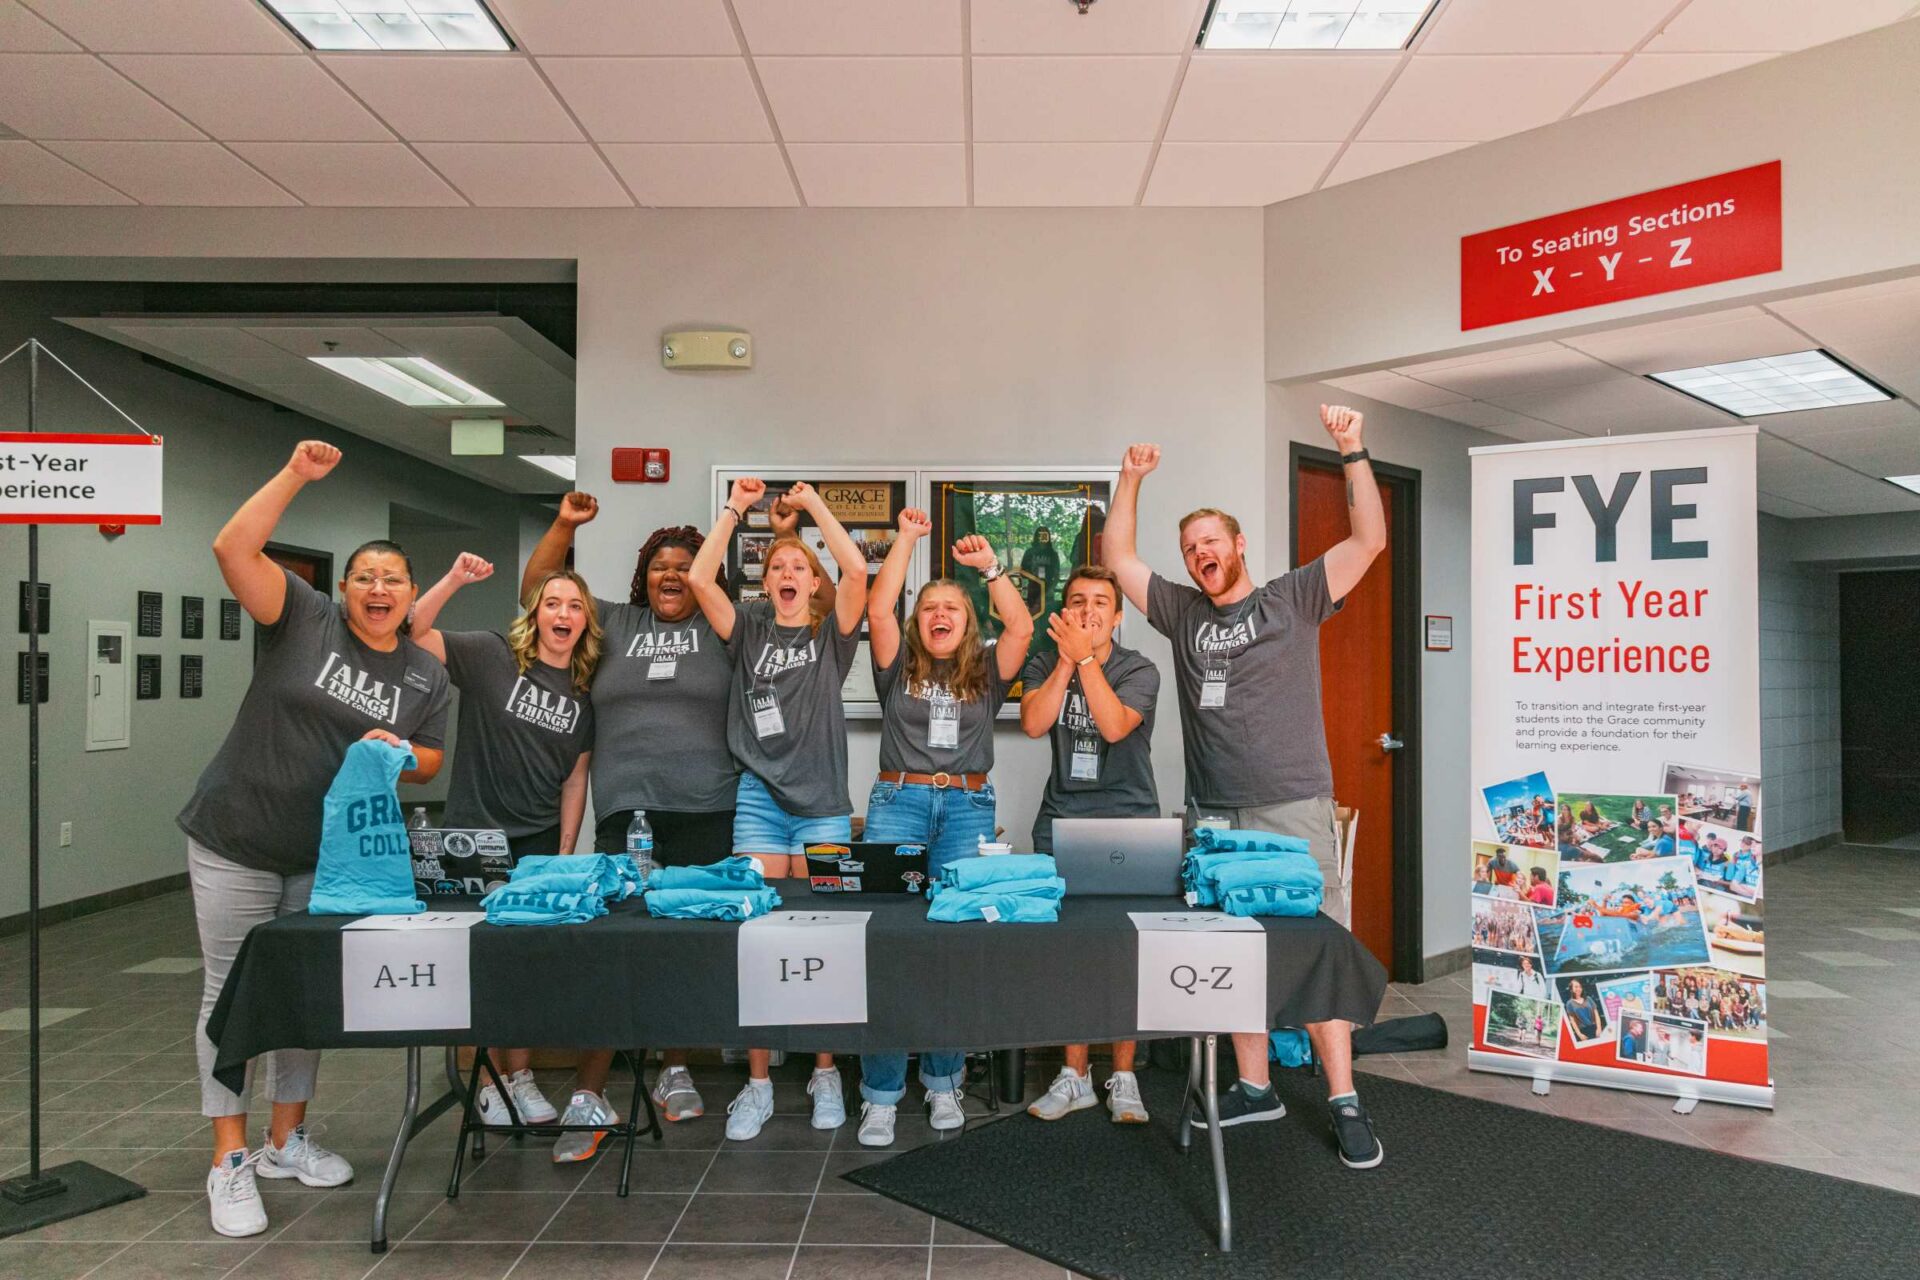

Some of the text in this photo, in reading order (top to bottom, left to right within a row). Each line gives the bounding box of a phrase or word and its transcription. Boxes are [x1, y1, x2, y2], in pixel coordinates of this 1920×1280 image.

[1496, 198, 1736, 265] To Seating Sections
[1531, 266, 1555, 296] X
[1598, 252, 1623, 281] Y
[1669, 236, 1692, 268] Z
[0, 479, 96, 499] erience
[824, 488, 885, 504] GRACE
[1513, 466, 1708, 566] FYE
[1515, 580, 1709, 620] First Year
[639, 631, 690, 648] ALL
[1201, 633, 1249, 651] THINGS
[1204, 622, 1246, 641] ALL
[1513, 636, 1710, 682] Experience
[331, 663, 391, 704] ALL
[327, 689, 384, 721] GRACE COLLEGE
[328, 678, 390, 717] THINGS
[520, 684, 573, 717] ALL
[1515, 701, 1706, 714] To transition and integrate first-year
[516, 700, 571, 729] THINGS
[537, 721, 564, 733] COLLEGE
[1515, 715, 1706, 728] students into the Grace community
[1515, 727, 1535, 737] and
[1538, 727, 1578, 739] provide
[1591, 728, 1650, 739] foundation
[1653, 729, 1668, 739] for
[1671, 729, 1697, 739] their
[1515, 741, 1621, 753] learning experience.
[373, 963, 436, 988] A-H
[779, 957, 824, 982] I-P
[1169, 965, 1233, 995] Q-Z
